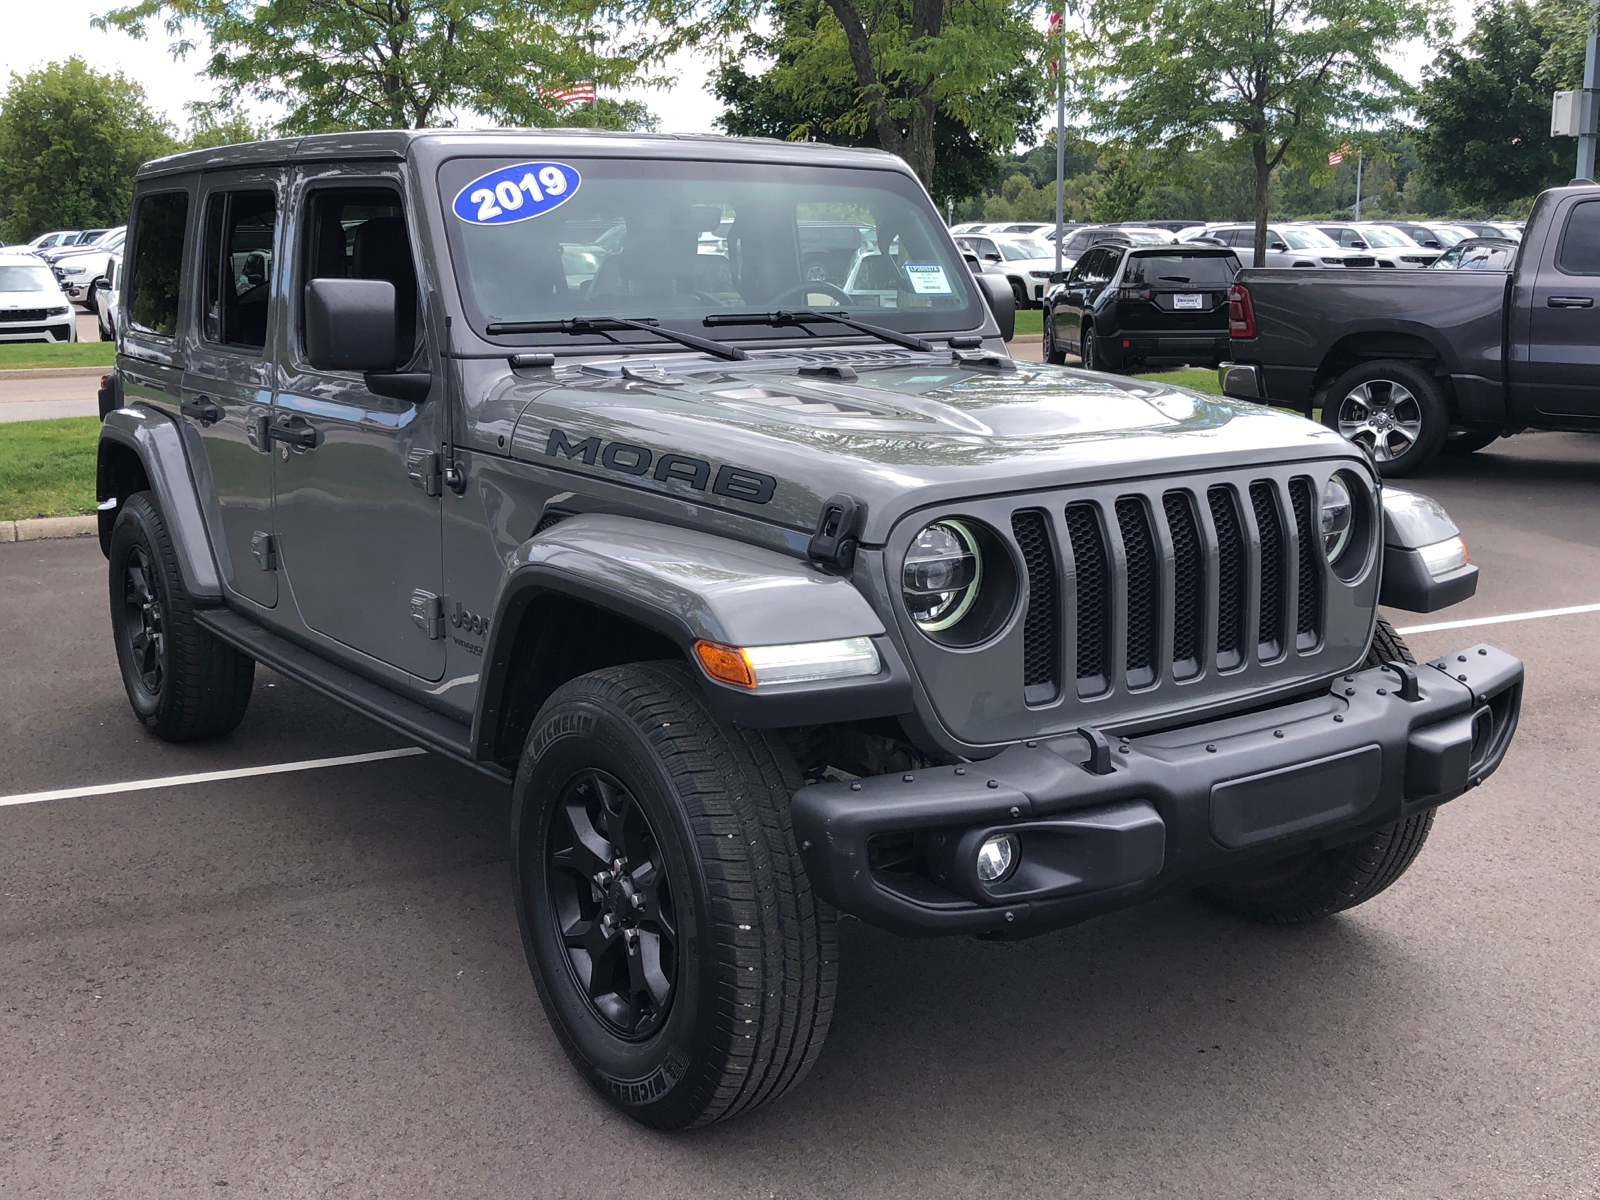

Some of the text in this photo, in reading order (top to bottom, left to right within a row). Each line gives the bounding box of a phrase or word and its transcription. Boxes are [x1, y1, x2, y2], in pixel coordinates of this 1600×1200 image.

[470, 166, 567, 222] 2019
[544, 428, 778, 504] MOAB
[450, 601, 491, 643] Jeep
[533, 714, 594, 757] MICHELIN
[595, 1069, 668, 1103] MICHELIN
